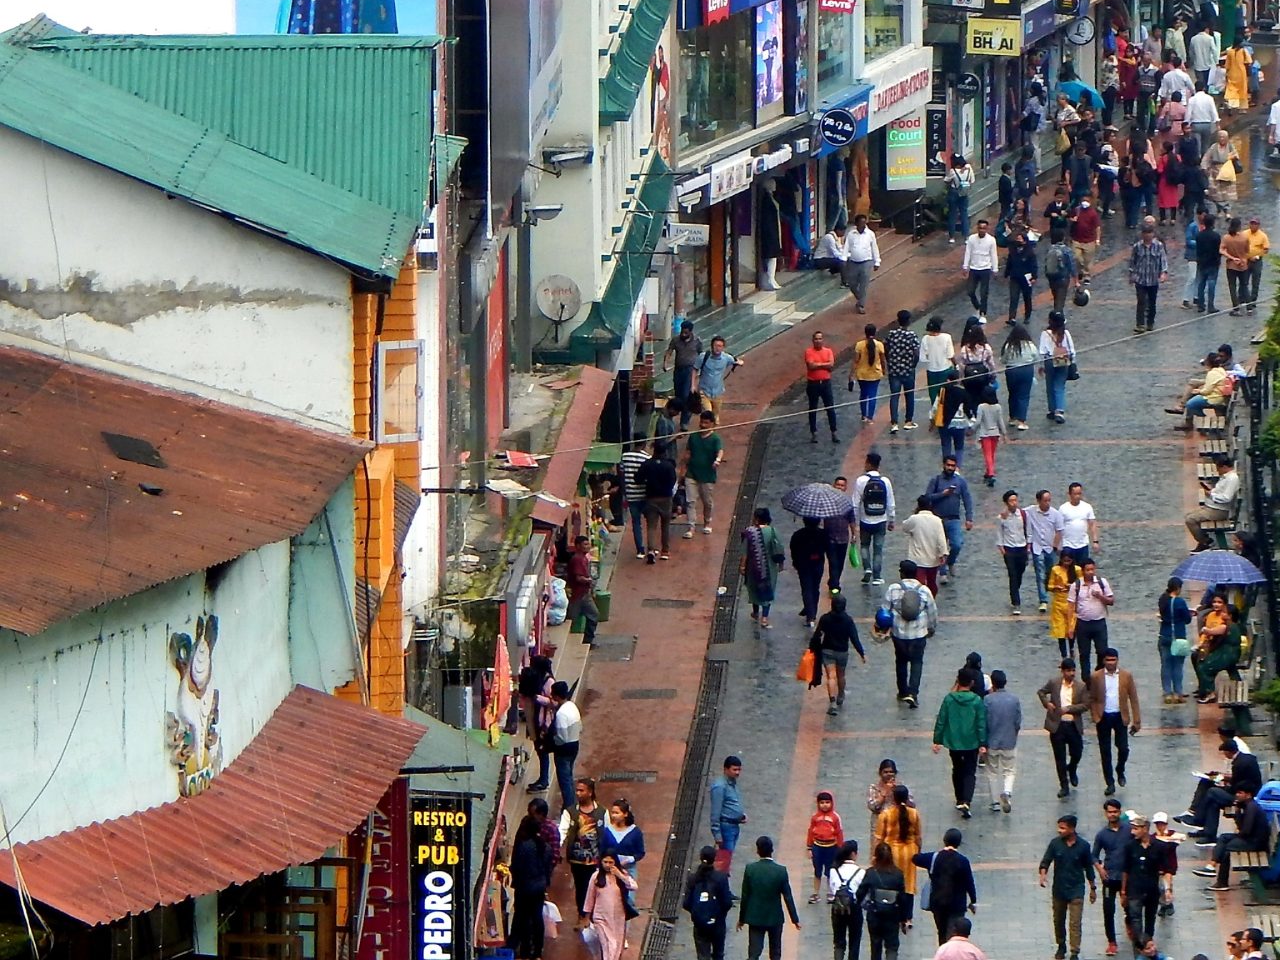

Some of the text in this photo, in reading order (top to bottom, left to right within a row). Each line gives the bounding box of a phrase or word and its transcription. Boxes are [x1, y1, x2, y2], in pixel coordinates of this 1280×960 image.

[890, 117, 920, 129] Food
[889, 129, 922, 141] Court
[413, 810, 467, 827] RESTRO
[434, 828, 445, 842] &
[418, 845, 460, 865] PUB
[423, 870, 453, 960] PEDRO
